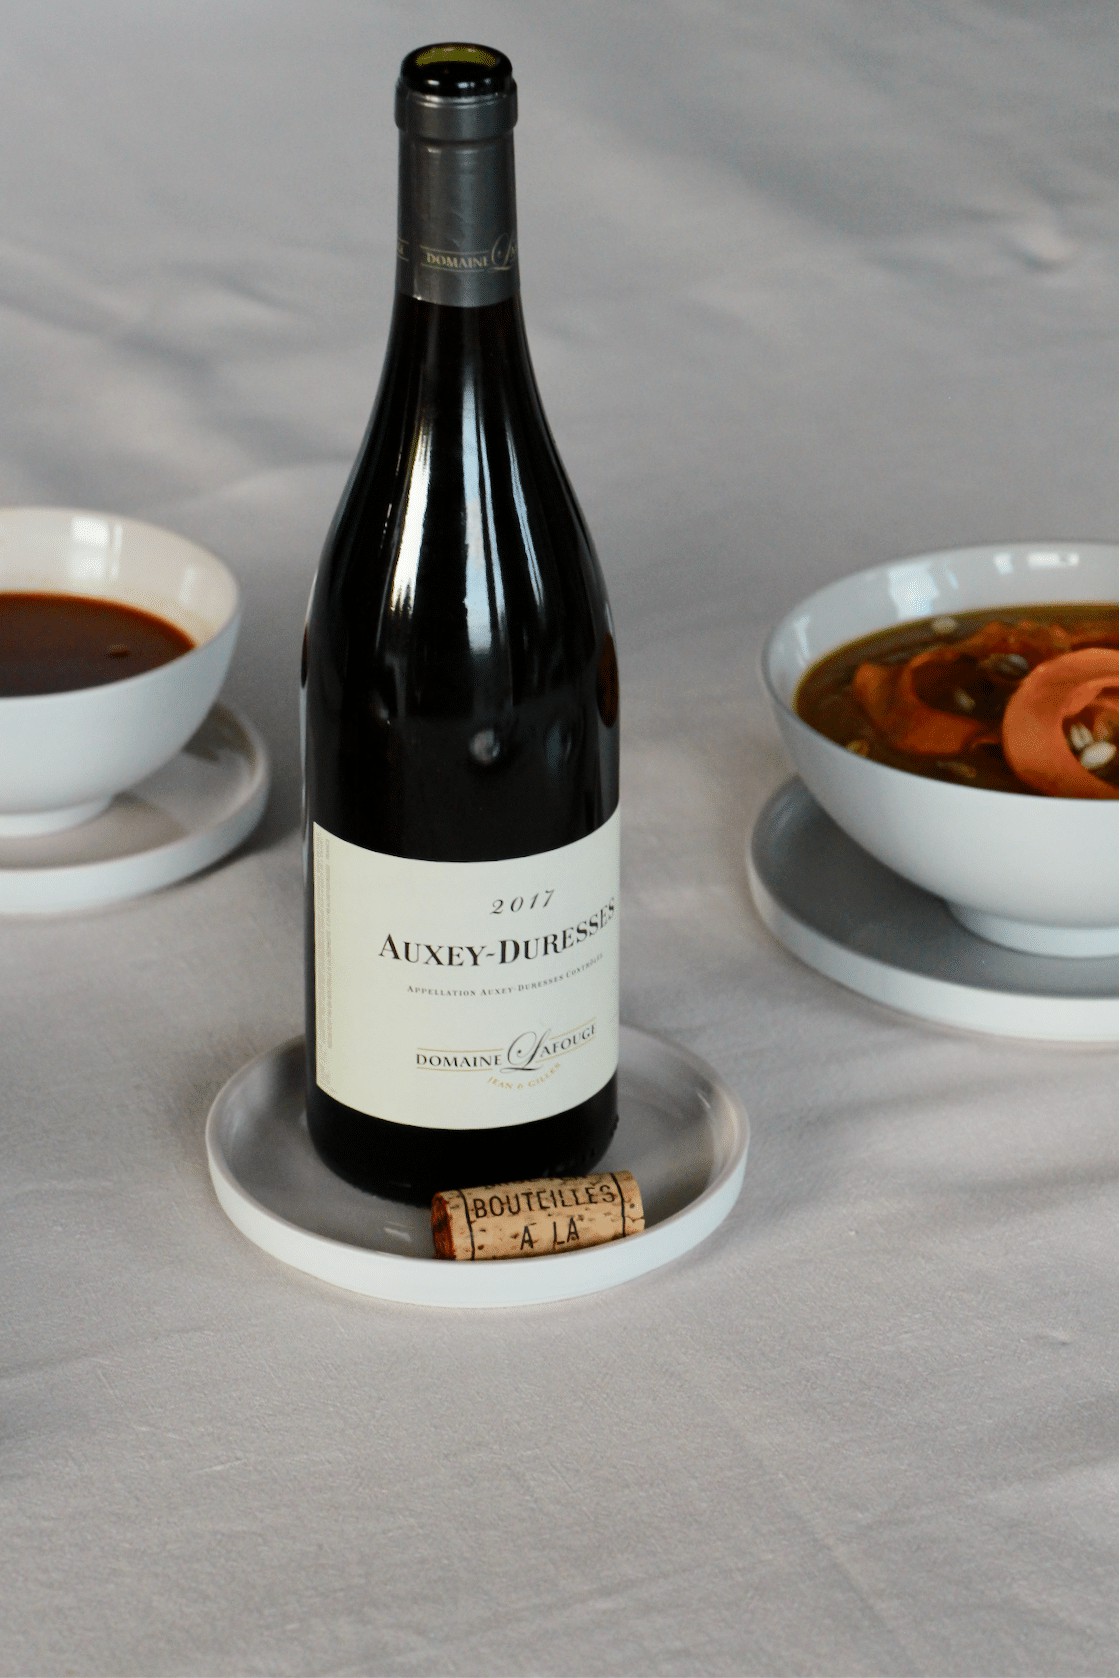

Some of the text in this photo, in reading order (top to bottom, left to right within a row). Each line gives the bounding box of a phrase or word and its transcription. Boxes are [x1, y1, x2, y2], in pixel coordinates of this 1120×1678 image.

[489, 889, 555, 915] 2017
[407, 985, 476, 997] APPELLATION
[416, 1053, 501, 1067] DOMAINE
[473, 1184, 616, 1219] BOUTEILLES
[553, 1216, 580, 1245] LA
